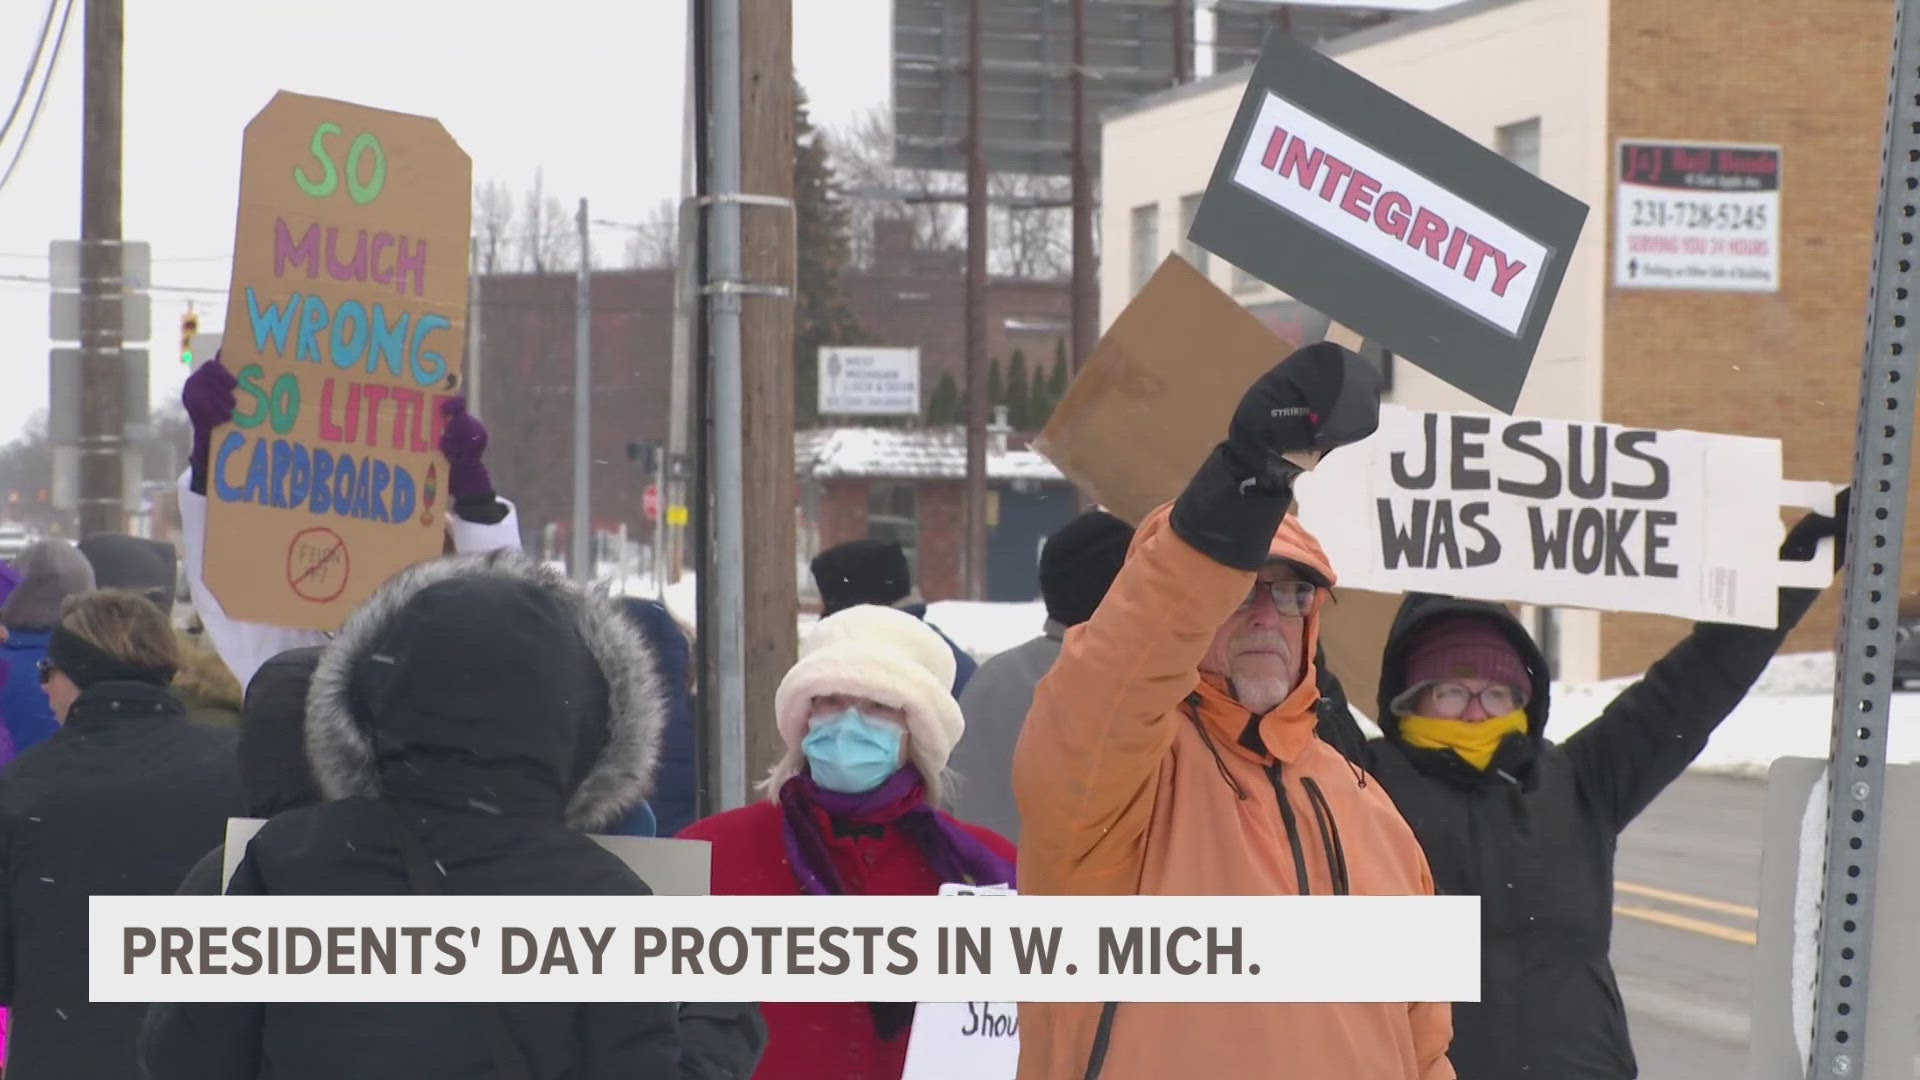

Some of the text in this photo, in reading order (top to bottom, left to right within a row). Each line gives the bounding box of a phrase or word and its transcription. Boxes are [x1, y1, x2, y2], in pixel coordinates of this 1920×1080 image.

[294, 121, 387, 205] SO
[1261, 125, 1527, 298] INTEGRITY
[1632, 200, 1767, 230] 231-728-5245
[274, 215, 426, 296] MUCH
[231, 363, 300, 434] SO
[1390, 413, 1669, 500] JESUS
[1376, 498, 1678, 578] WAS WOKE
